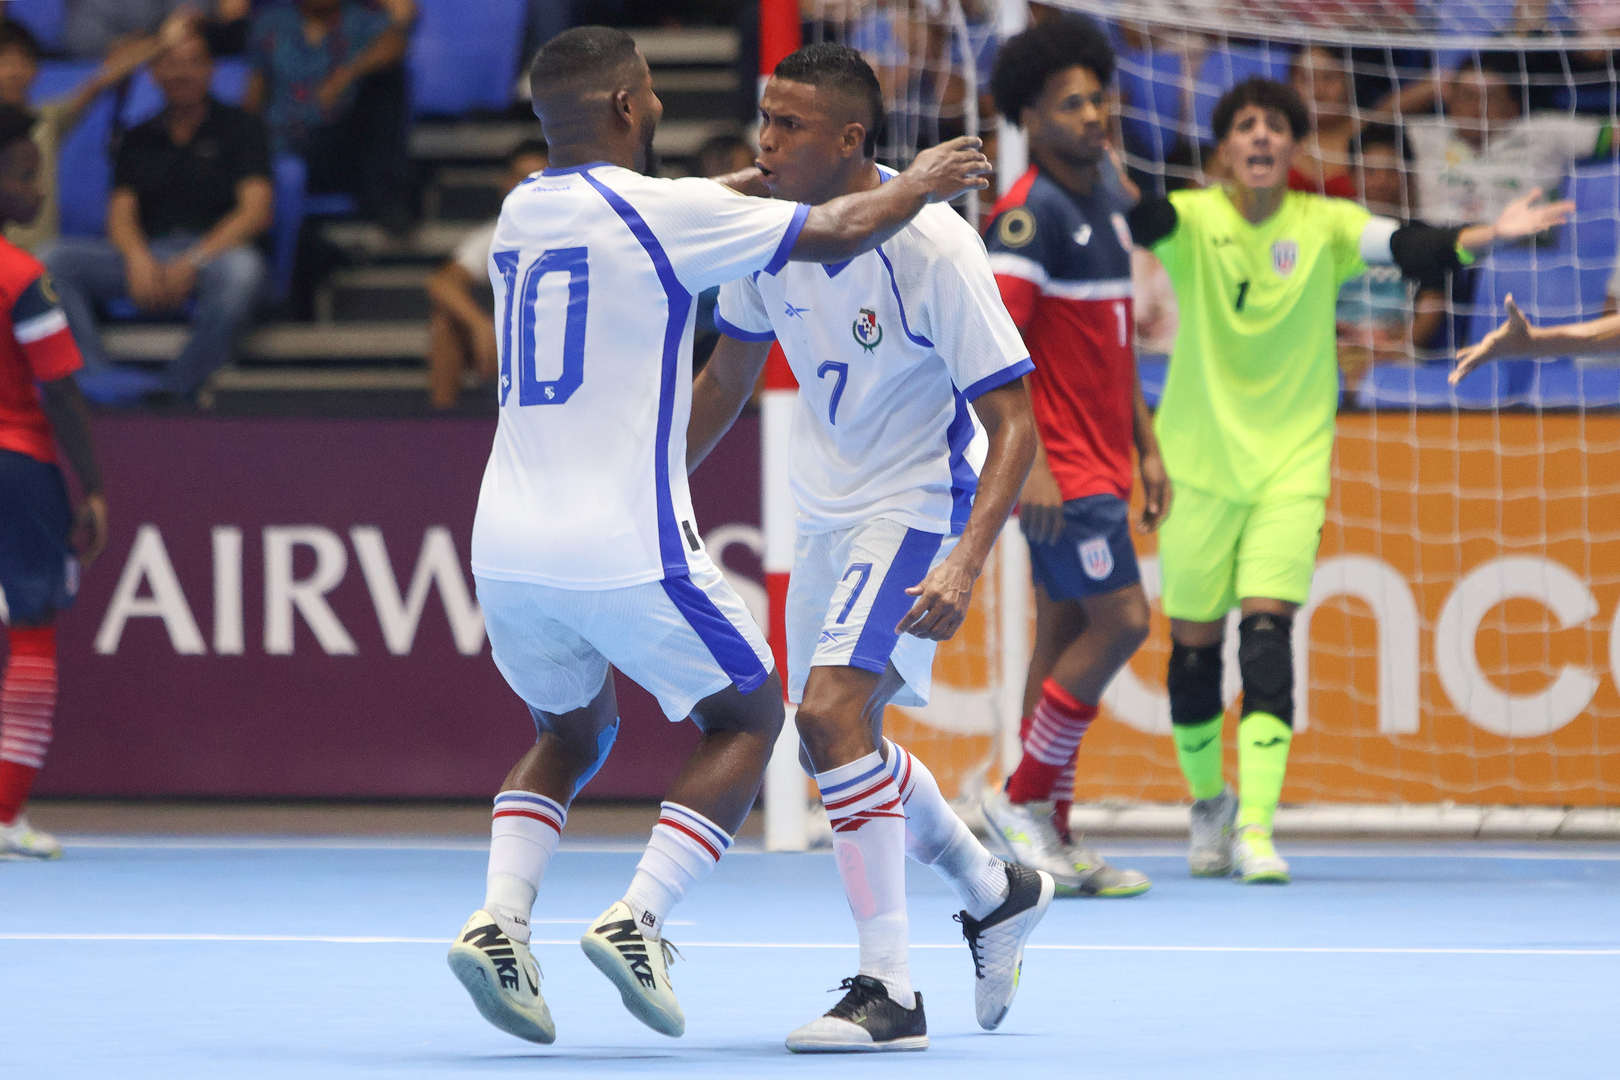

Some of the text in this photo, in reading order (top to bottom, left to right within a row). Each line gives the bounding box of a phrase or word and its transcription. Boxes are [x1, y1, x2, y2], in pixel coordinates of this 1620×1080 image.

[493, 247, 589, 407] 10
[1235, 279, 1251, 312] 1
[817, 360, 848, 426] 7
[95, 524, 769, 655] AIRWS
[836, 563, 873, 625] 7
[463, 924, 519, 992] NIKE
[594, 919, 656, 990] NIKE
